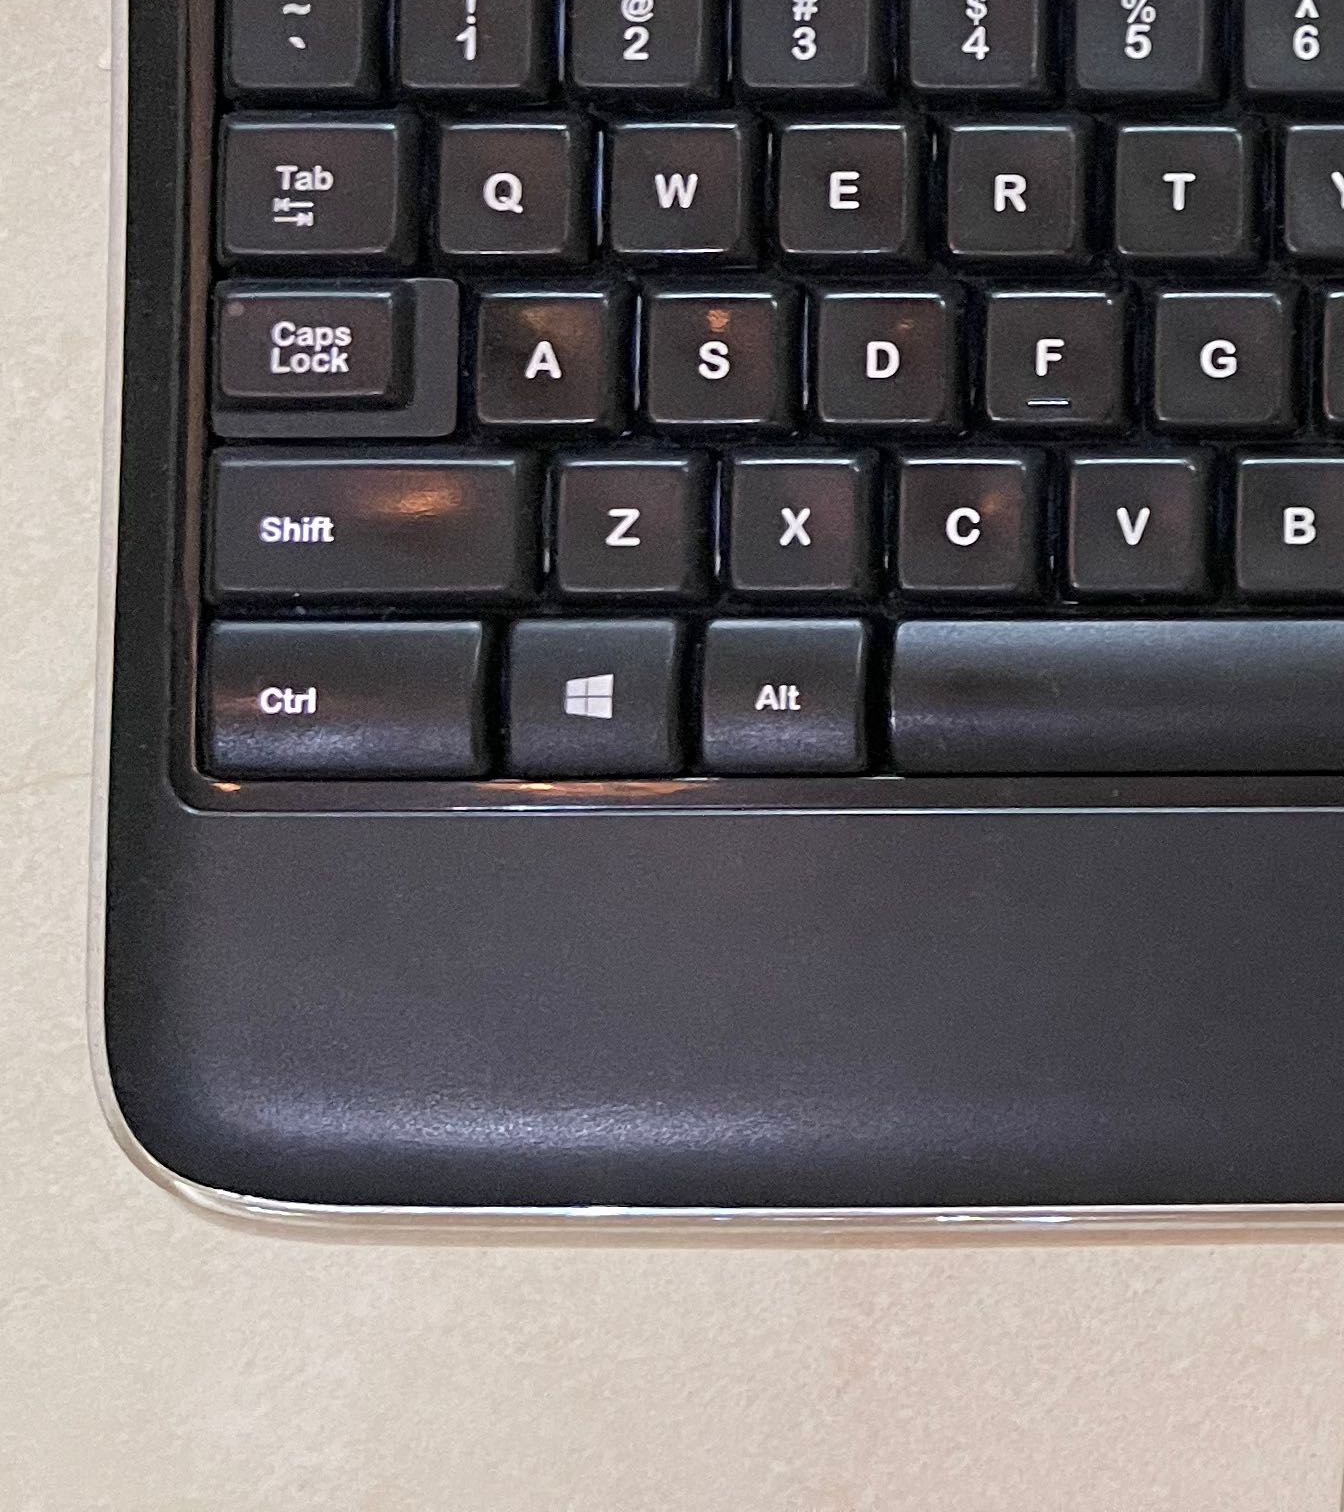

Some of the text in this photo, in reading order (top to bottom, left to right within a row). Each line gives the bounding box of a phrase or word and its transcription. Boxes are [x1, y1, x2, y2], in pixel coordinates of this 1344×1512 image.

[455, 25, 477, 61] 1
[623, 26, 649, 61] 2
[791, 26, 817, 61] 3
[961, 26, 990, 61] 4
[1124, 24, 1152, 60] 5
[1293, 24, 1320, 60] 6
[275, 165, 334, 191] Tab
[483, 172, 524, 214] Q
[654, 173, 699, 209] W
[829, 171, 860, 210] E
[994, 174, 1027, 212] R
[1162, 172, 1196, 211] T
[271, 320, 352, 352] Caps
[270, 345, 349, 374] Lock
[525, 340, 562, 379] A
[698, 340, 730, 380] S
[866, 340, 900, 379] D
[1035, 338, 1065, 377] F
[1200, 339, 1237, 378] G
[260, 516, 335, 543] Shift
[605, 508, 641, 547] Z
[779, 507, 811, 546] X
[945, 507, 981, 546] C
[1116, 507, 1151, 546] V
[1283, 506, 1316, 545] B
[256, 686, 317, 715] Ctrl
[754, 684, 801, 711] Alt
